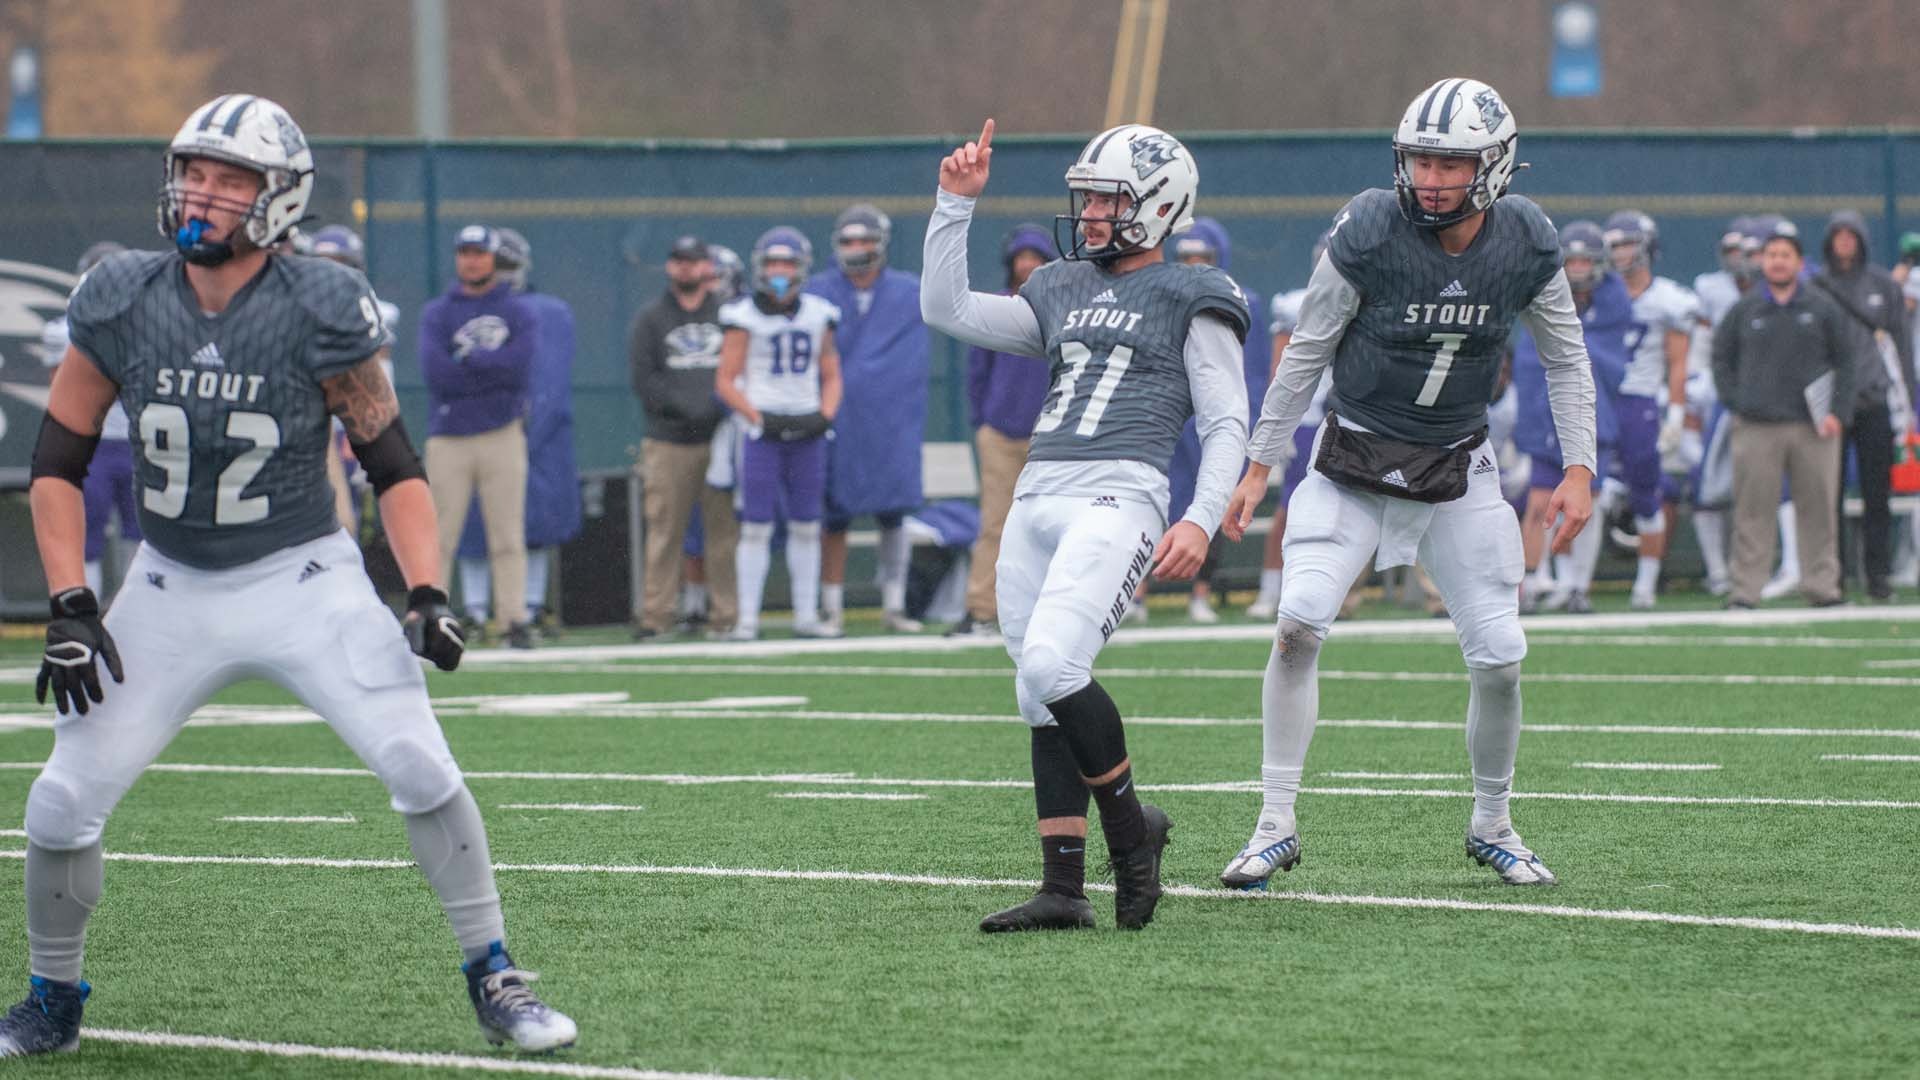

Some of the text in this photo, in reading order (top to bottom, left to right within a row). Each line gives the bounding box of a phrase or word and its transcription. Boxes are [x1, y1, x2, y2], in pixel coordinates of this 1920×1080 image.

[1062, 307, 1143, 332] STOUT
[1403, 303, 1491, 326] STOUT
[769, 330, 813, 375] 18
[1414, 332, 1469, 408] 7
[155, 367, 266, 404] STOUT
[138, 401, 281, 526] 92
[1122, 531, 1155, 601] DEVILS
